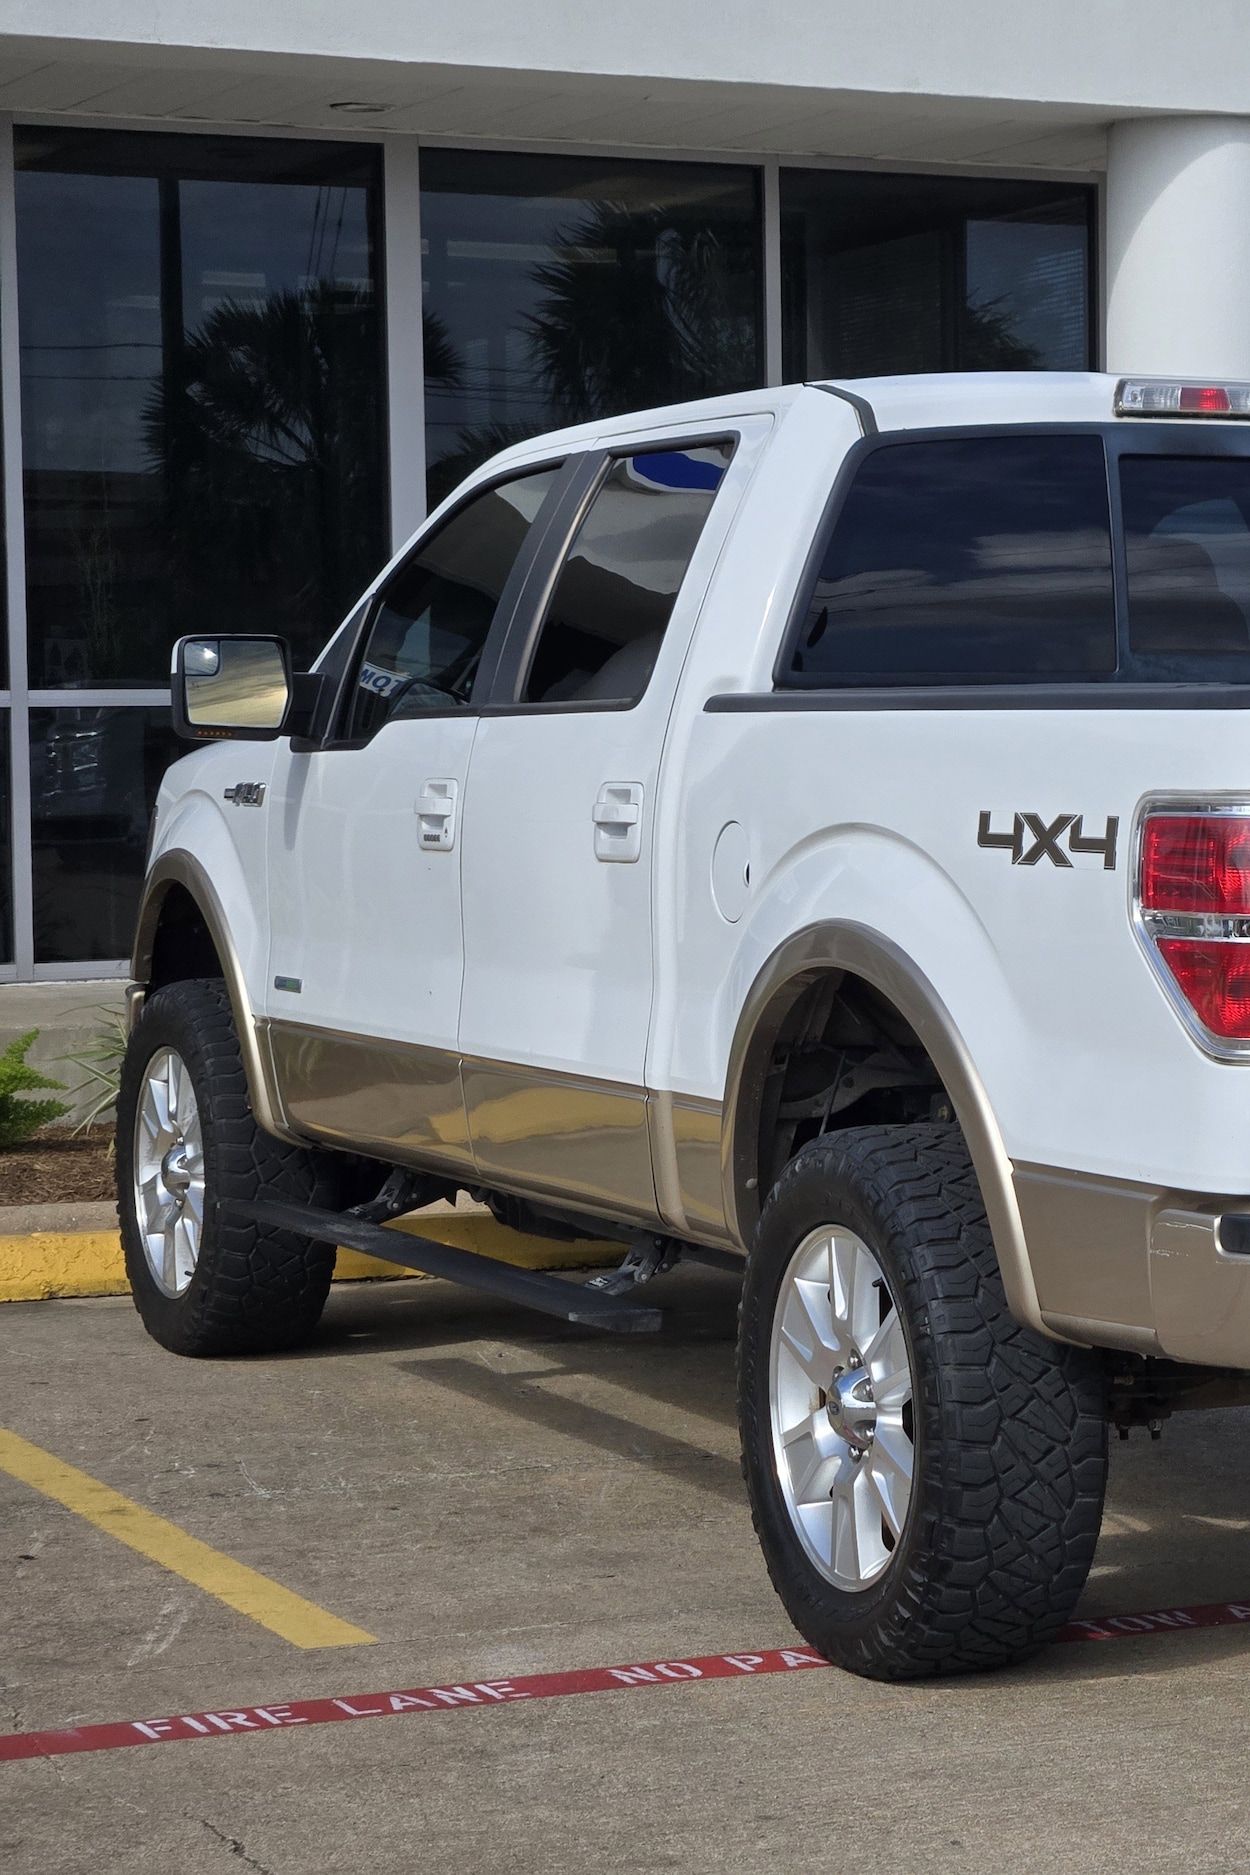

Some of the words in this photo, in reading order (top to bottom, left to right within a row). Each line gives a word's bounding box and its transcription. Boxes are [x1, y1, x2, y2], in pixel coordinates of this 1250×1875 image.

[978, 810, 1119, 871] 4X4
[131, 1705, 308, 1739] FIRE
[332, 1681, 531, 1716] LANE
[606, 1662, 703, 1684] NO
[1069, 1610, 1197, 1636] TOW
